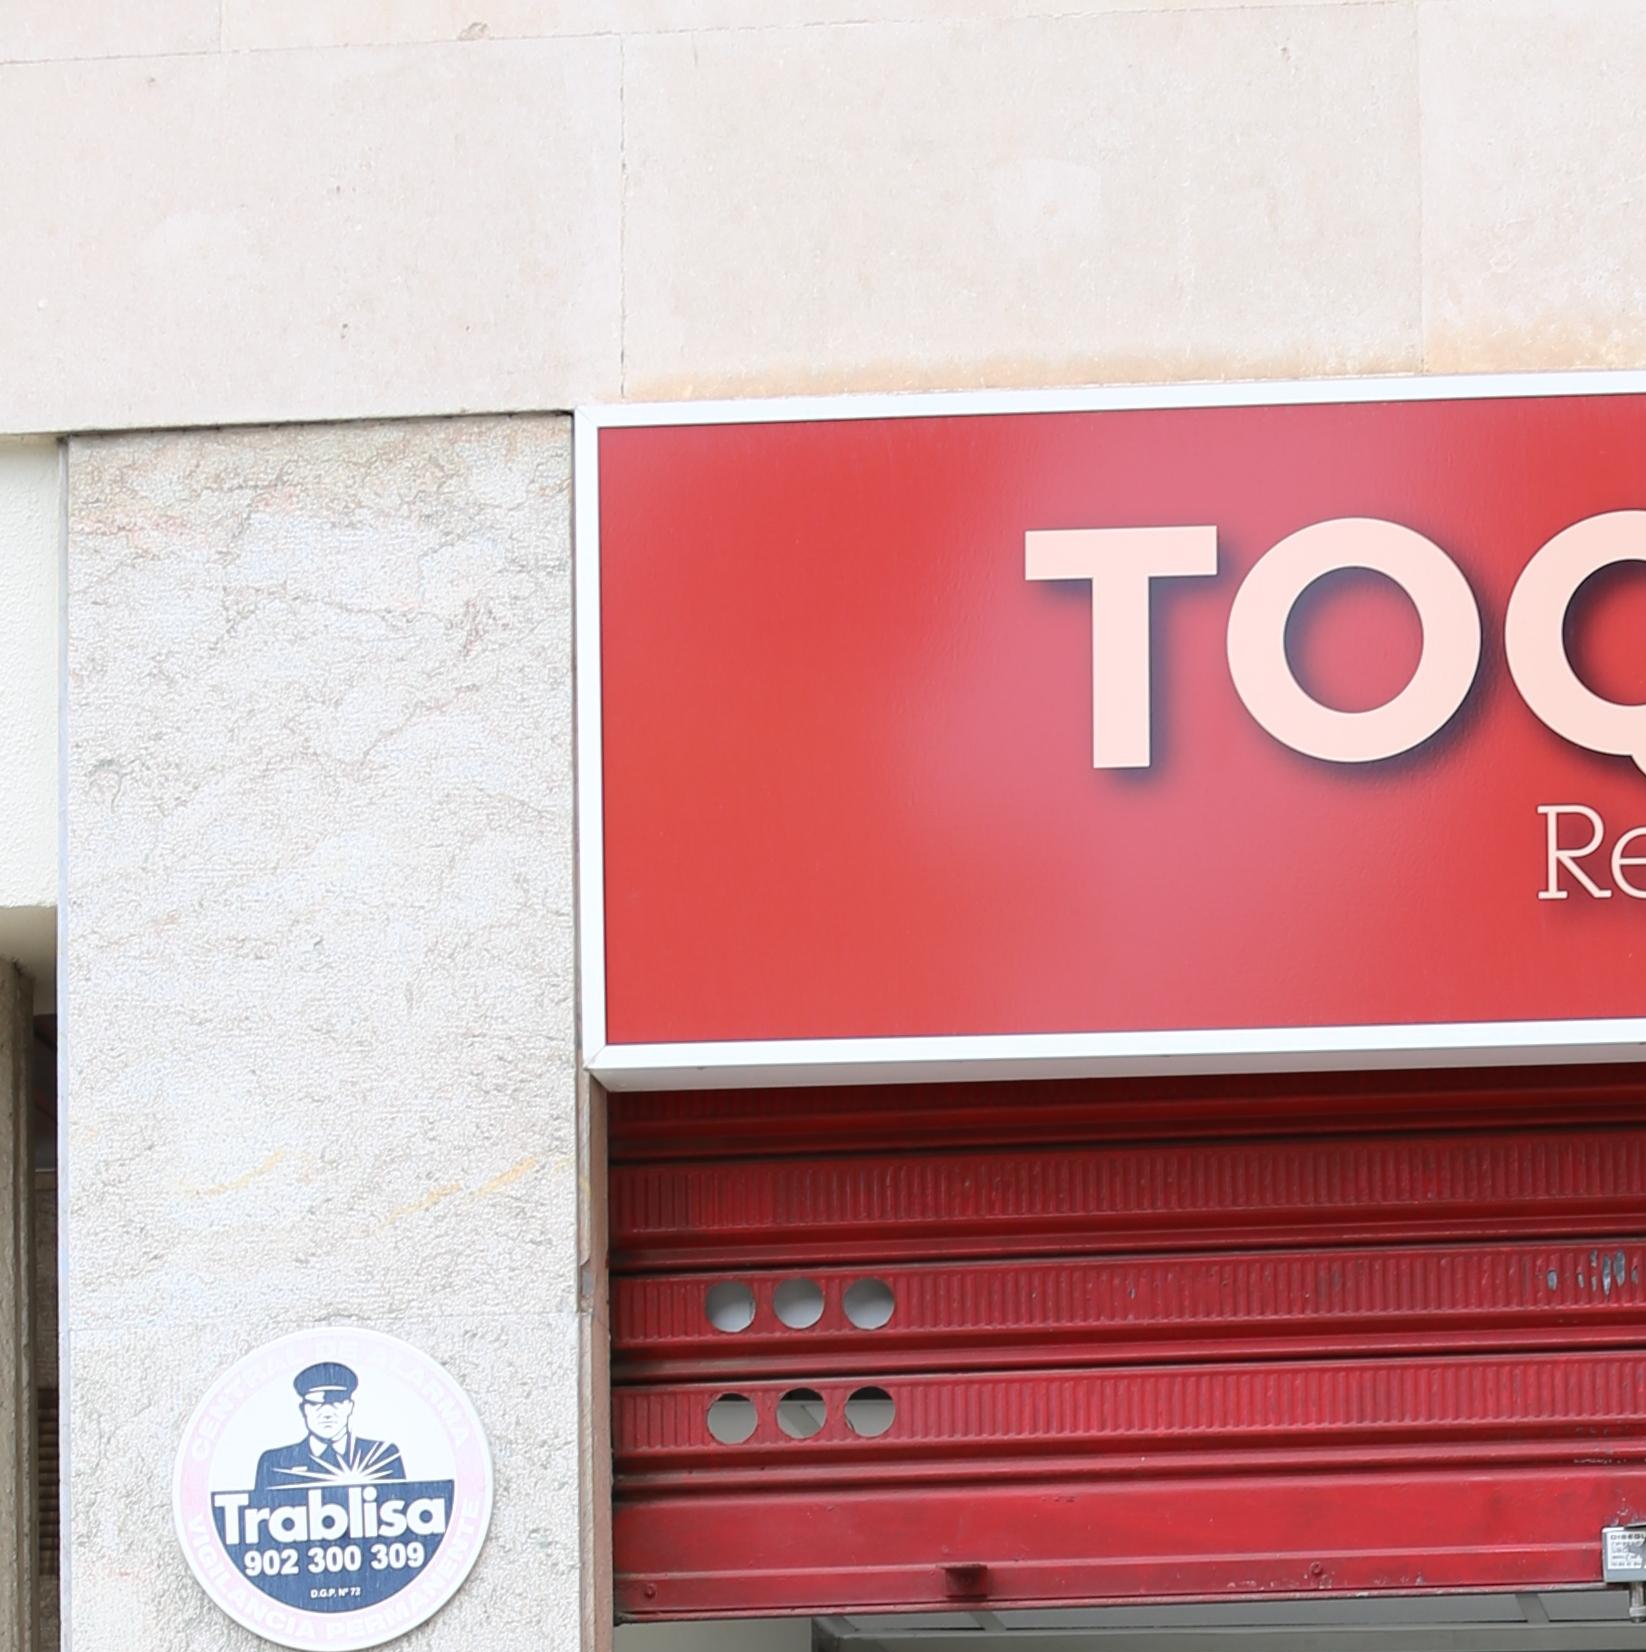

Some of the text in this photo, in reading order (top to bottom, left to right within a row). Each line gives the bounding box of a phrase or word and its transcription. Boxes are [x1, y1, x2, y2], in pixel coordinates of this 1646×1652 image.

[214, 1487, 446, 1545] Trablisa
[244, 1542, 424, 1576] 902 300 309
[326, 1497, 479, 1640] PERMANENTE
